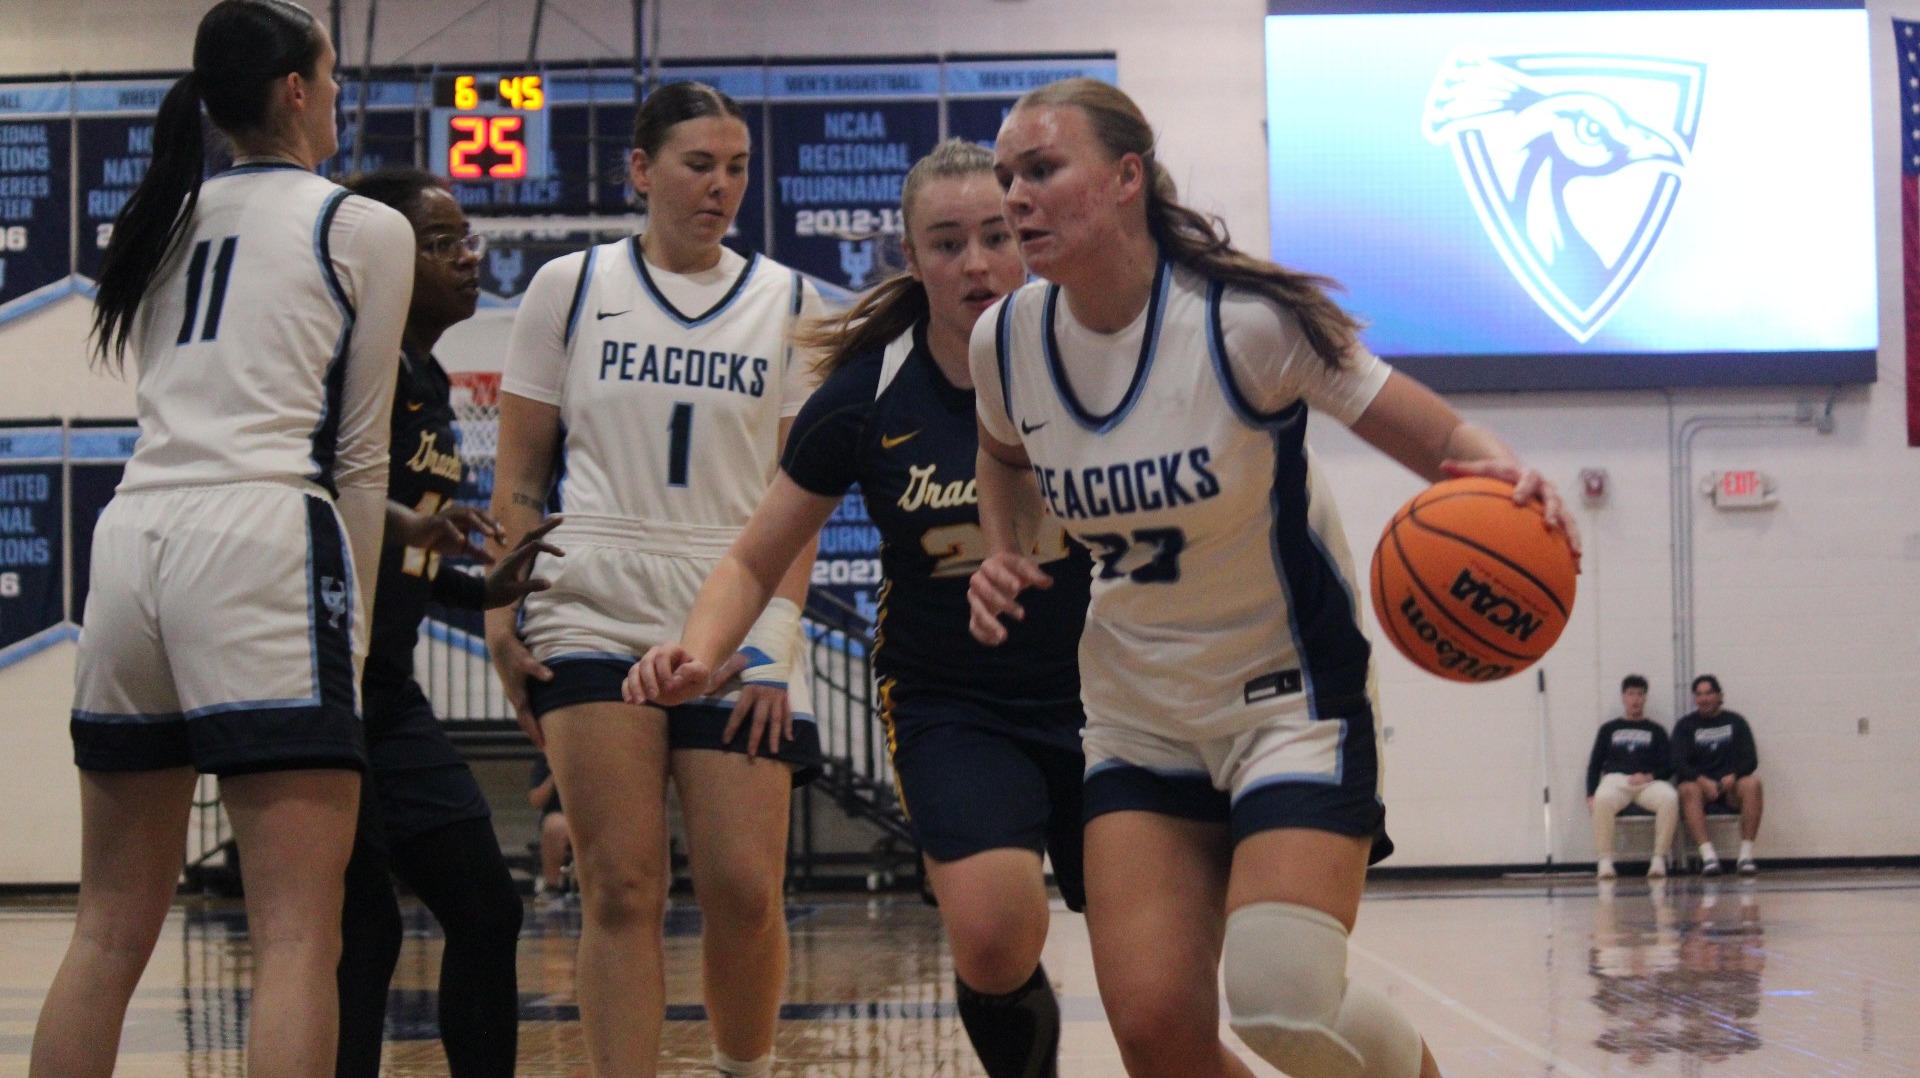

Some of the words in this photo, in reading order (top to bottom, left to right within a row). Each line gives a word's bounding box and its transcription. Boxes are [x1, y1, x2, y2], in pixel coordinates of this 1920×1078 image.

[454, 74, 477, 112] 6
[499, 75, 543, 112] 45
[824, 112, 886, 138] NCAA
[449, 116, 527, 178] 25
[799, 144, 910, 171] REGIONAL
[0, 176, 50, 198] ERIES
[780, 175, 905, 204] TOURNAME
[176, 235, 239, 346] 11
[600, 340, 768, 398] PEACOCKS
[666, 402, 694, 487] 1
[897, 463, 978, 512] Grac
[1724, 471, 1757, 496] EXIT
[0, 508, 36, 532] NAL
[0, 537, 50, 565] IONS
[1451, 568, 1544, 642] NCAA
